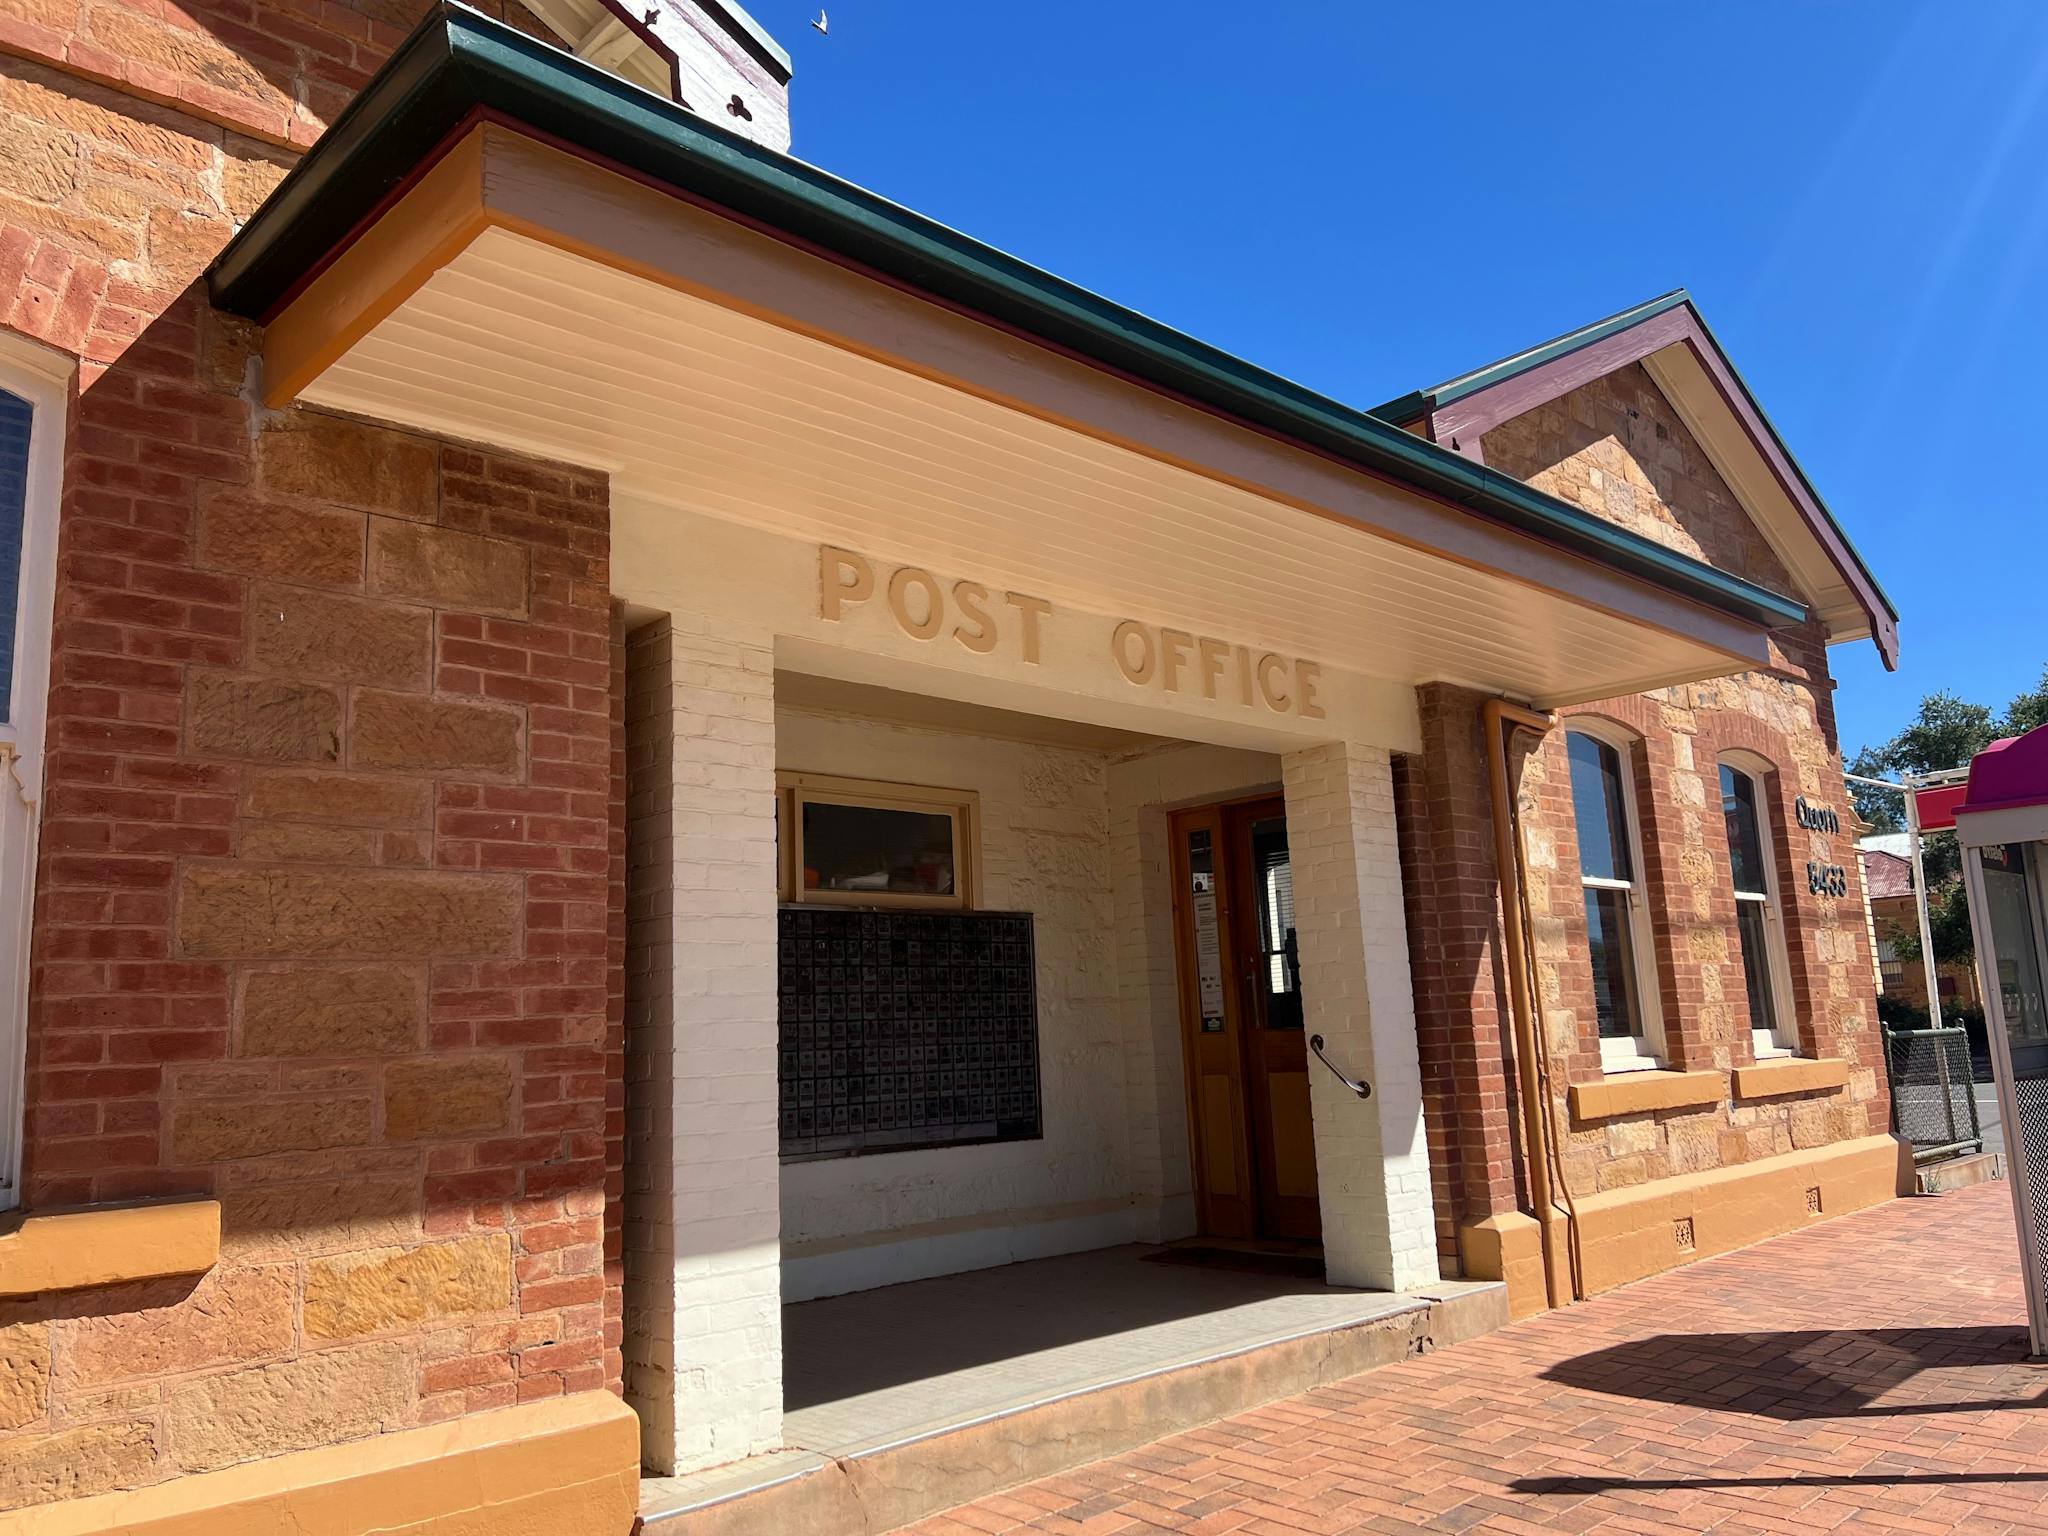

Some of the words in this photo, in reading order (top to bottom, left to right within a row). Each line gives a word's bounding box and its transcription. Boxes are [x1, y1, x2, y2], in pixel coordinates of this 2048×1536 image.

[819, 544, 1051, 665] POST
[1111, 619, 1325, 719] OFFICE
[1795, 794, 1840, 835] Quorn
[1807, 860, 1848, 897] 5433
